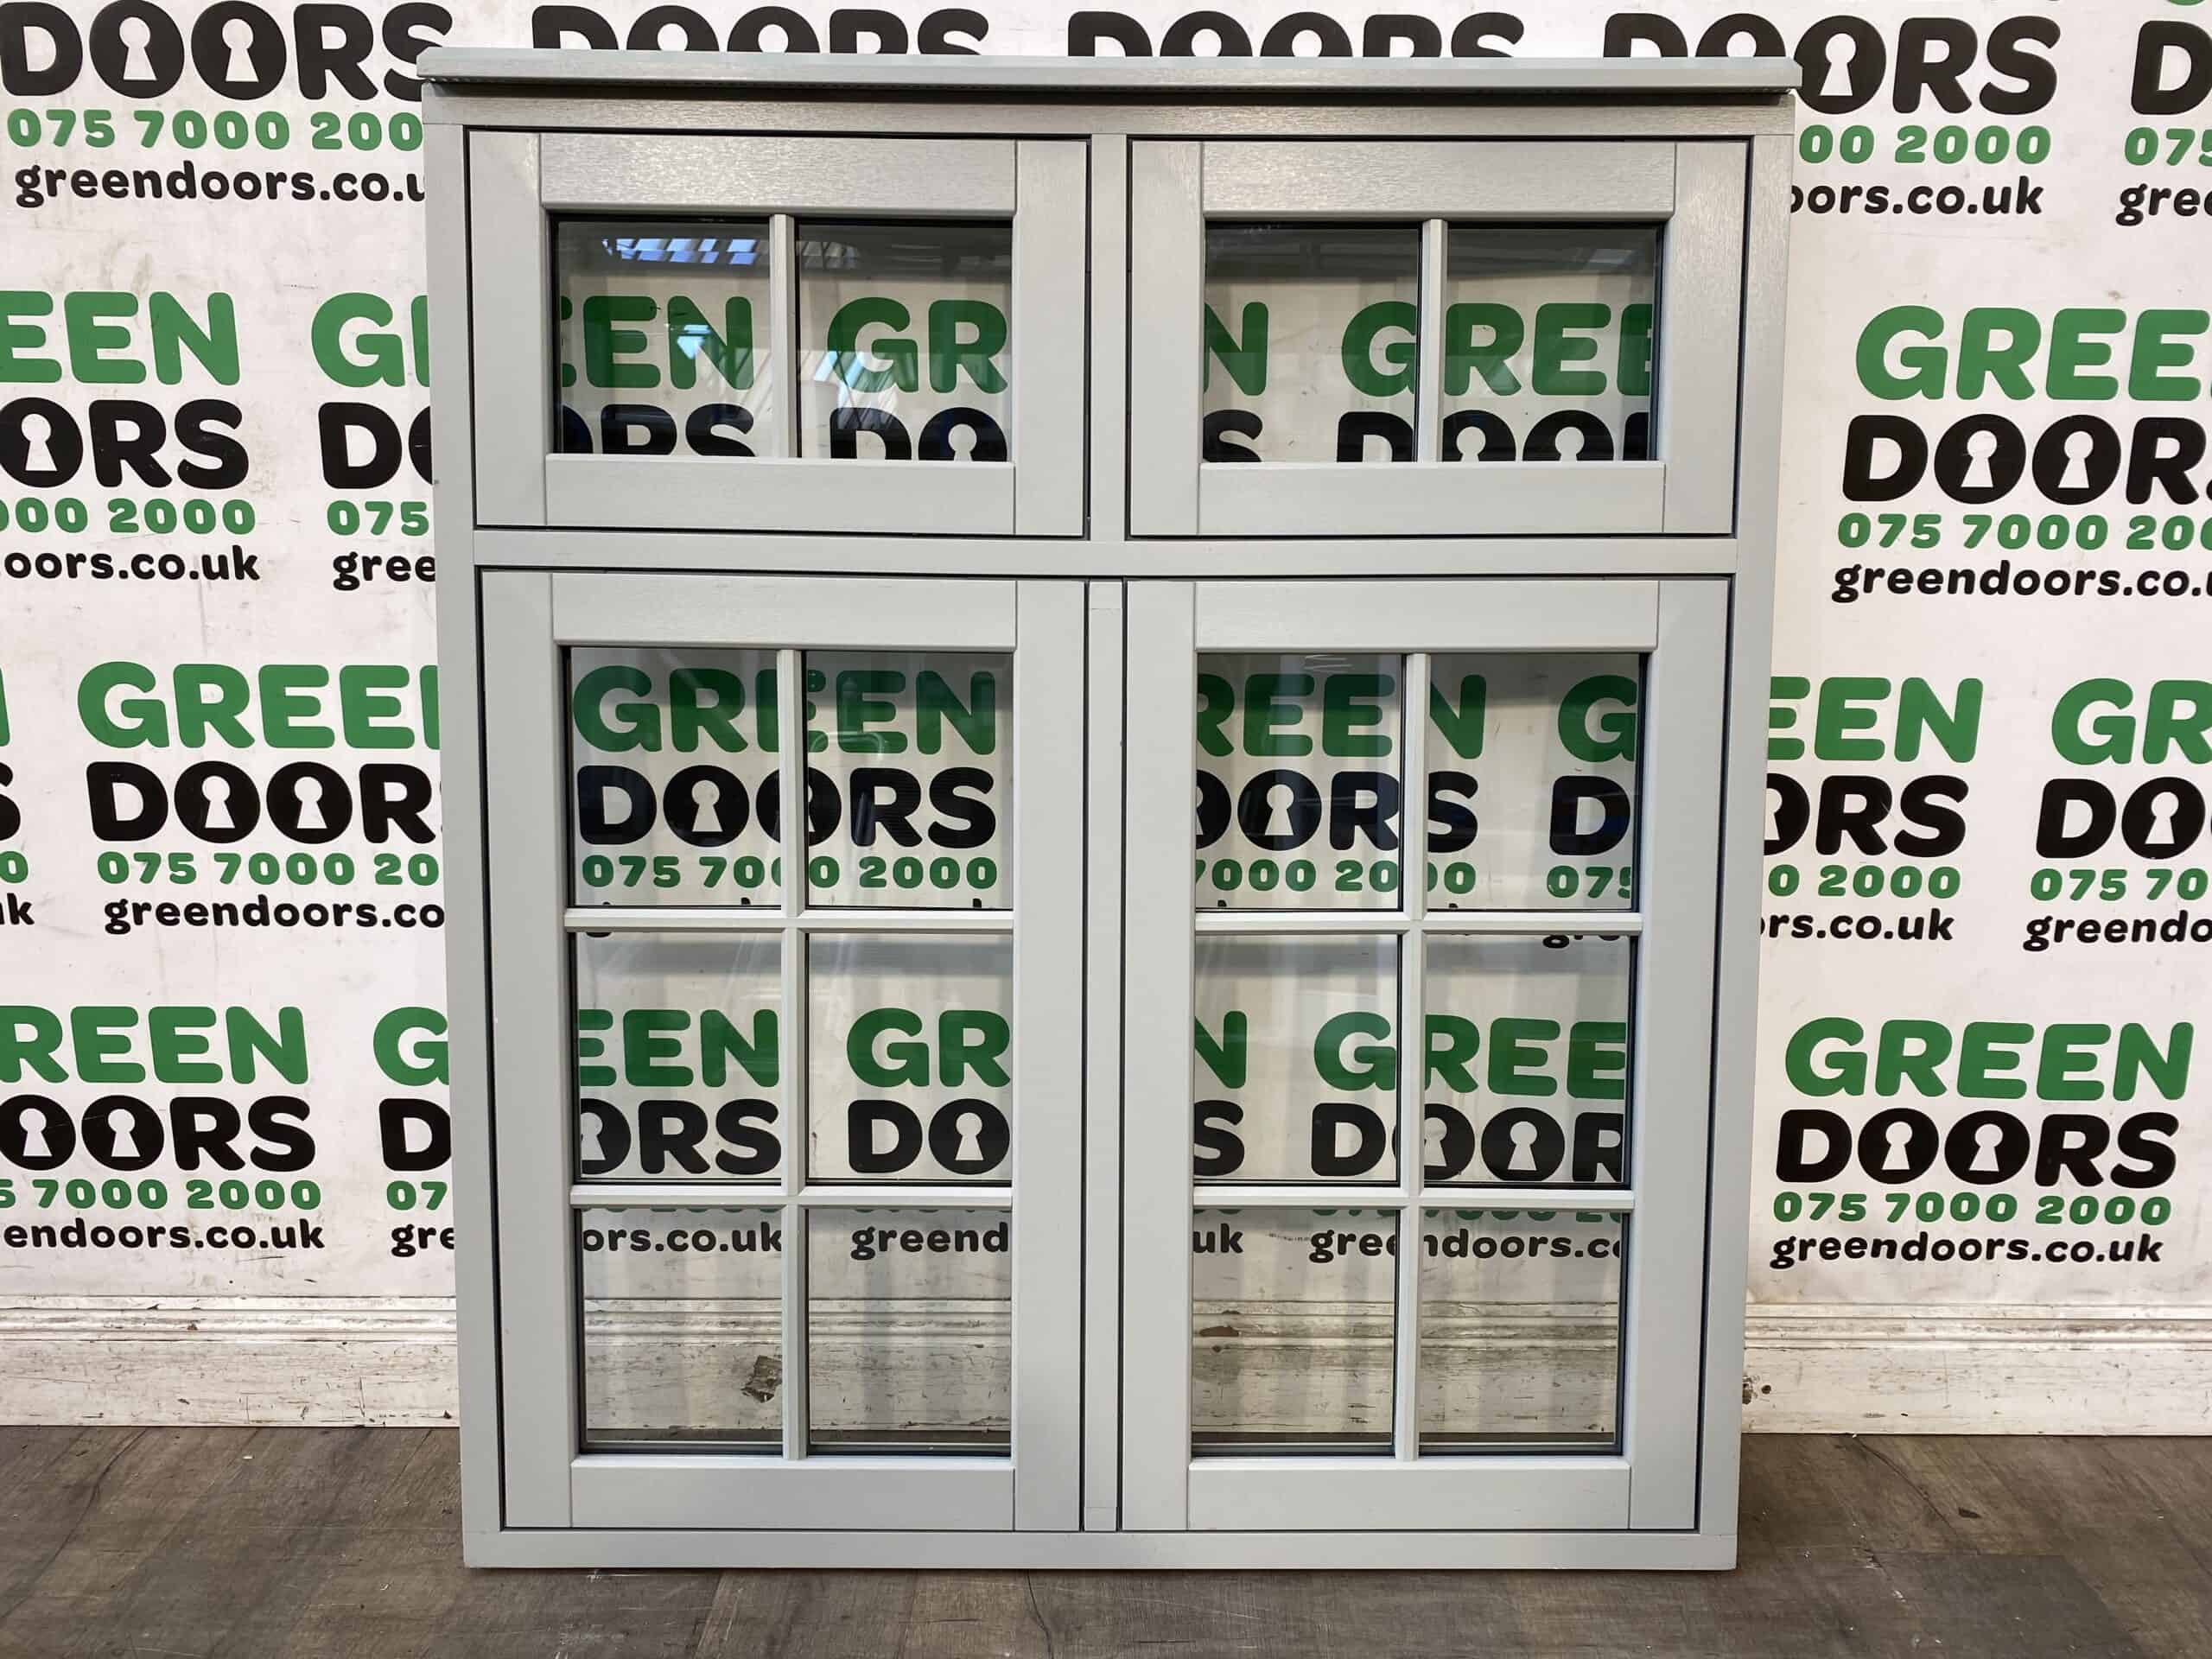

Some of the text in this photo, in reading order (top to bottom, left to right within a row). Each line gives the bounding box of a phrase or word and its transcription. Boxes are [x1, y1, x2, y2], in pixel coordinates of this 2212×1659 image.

[0, 0, 453, 101] DOORS
[8, 109, 423, 151] 075 7000 200
[1894, 126, 2051, 164] 2000
[561, 296, 753, 390] EN
[1842, 414, 2212, 505] DOOR
[0, 498, 255, 533] 00 2000
[327, 500, 429, 536] 075
[1837, 512, 1942, 548] 075
[1962, 514, 2108, 550] 7000
[4, 545, 260, 580] oors.co.uk
[1831, 560, 2212, 603] greendoors.co.
[78, 662, 440, 749] GREE
[574, 665, 995, 755] GREEN
[577, 765, 995, 849] DOORS
[98, 852, 197, 885] 075
[213, 853, 355, 885] 7000
[582, 855, 681, 888] 075
[859, 856, 997, 889] 2000
[1817, 865, 1961, 899] 2000
[2031, 868, 2209, 901] 075 70
[1760, 908, 1955, 941] rs.co.uk
[1785, 1017, 2194, 1101] GREEN
[1776, 1108, 2179, 1188] DOORS
[32, 1179, 168, 1209] 7000
[186, 1179, 321, 1210] 2000
[1773, 1192, 2171, 1225] 075 7000 2000
[4, 1218, 325, 1249] endoors.co.uk
[1309, 1229, 1620, 1263] grendoors.c
[1770, 1231, 2164, 1269] greendoors.co.uk
